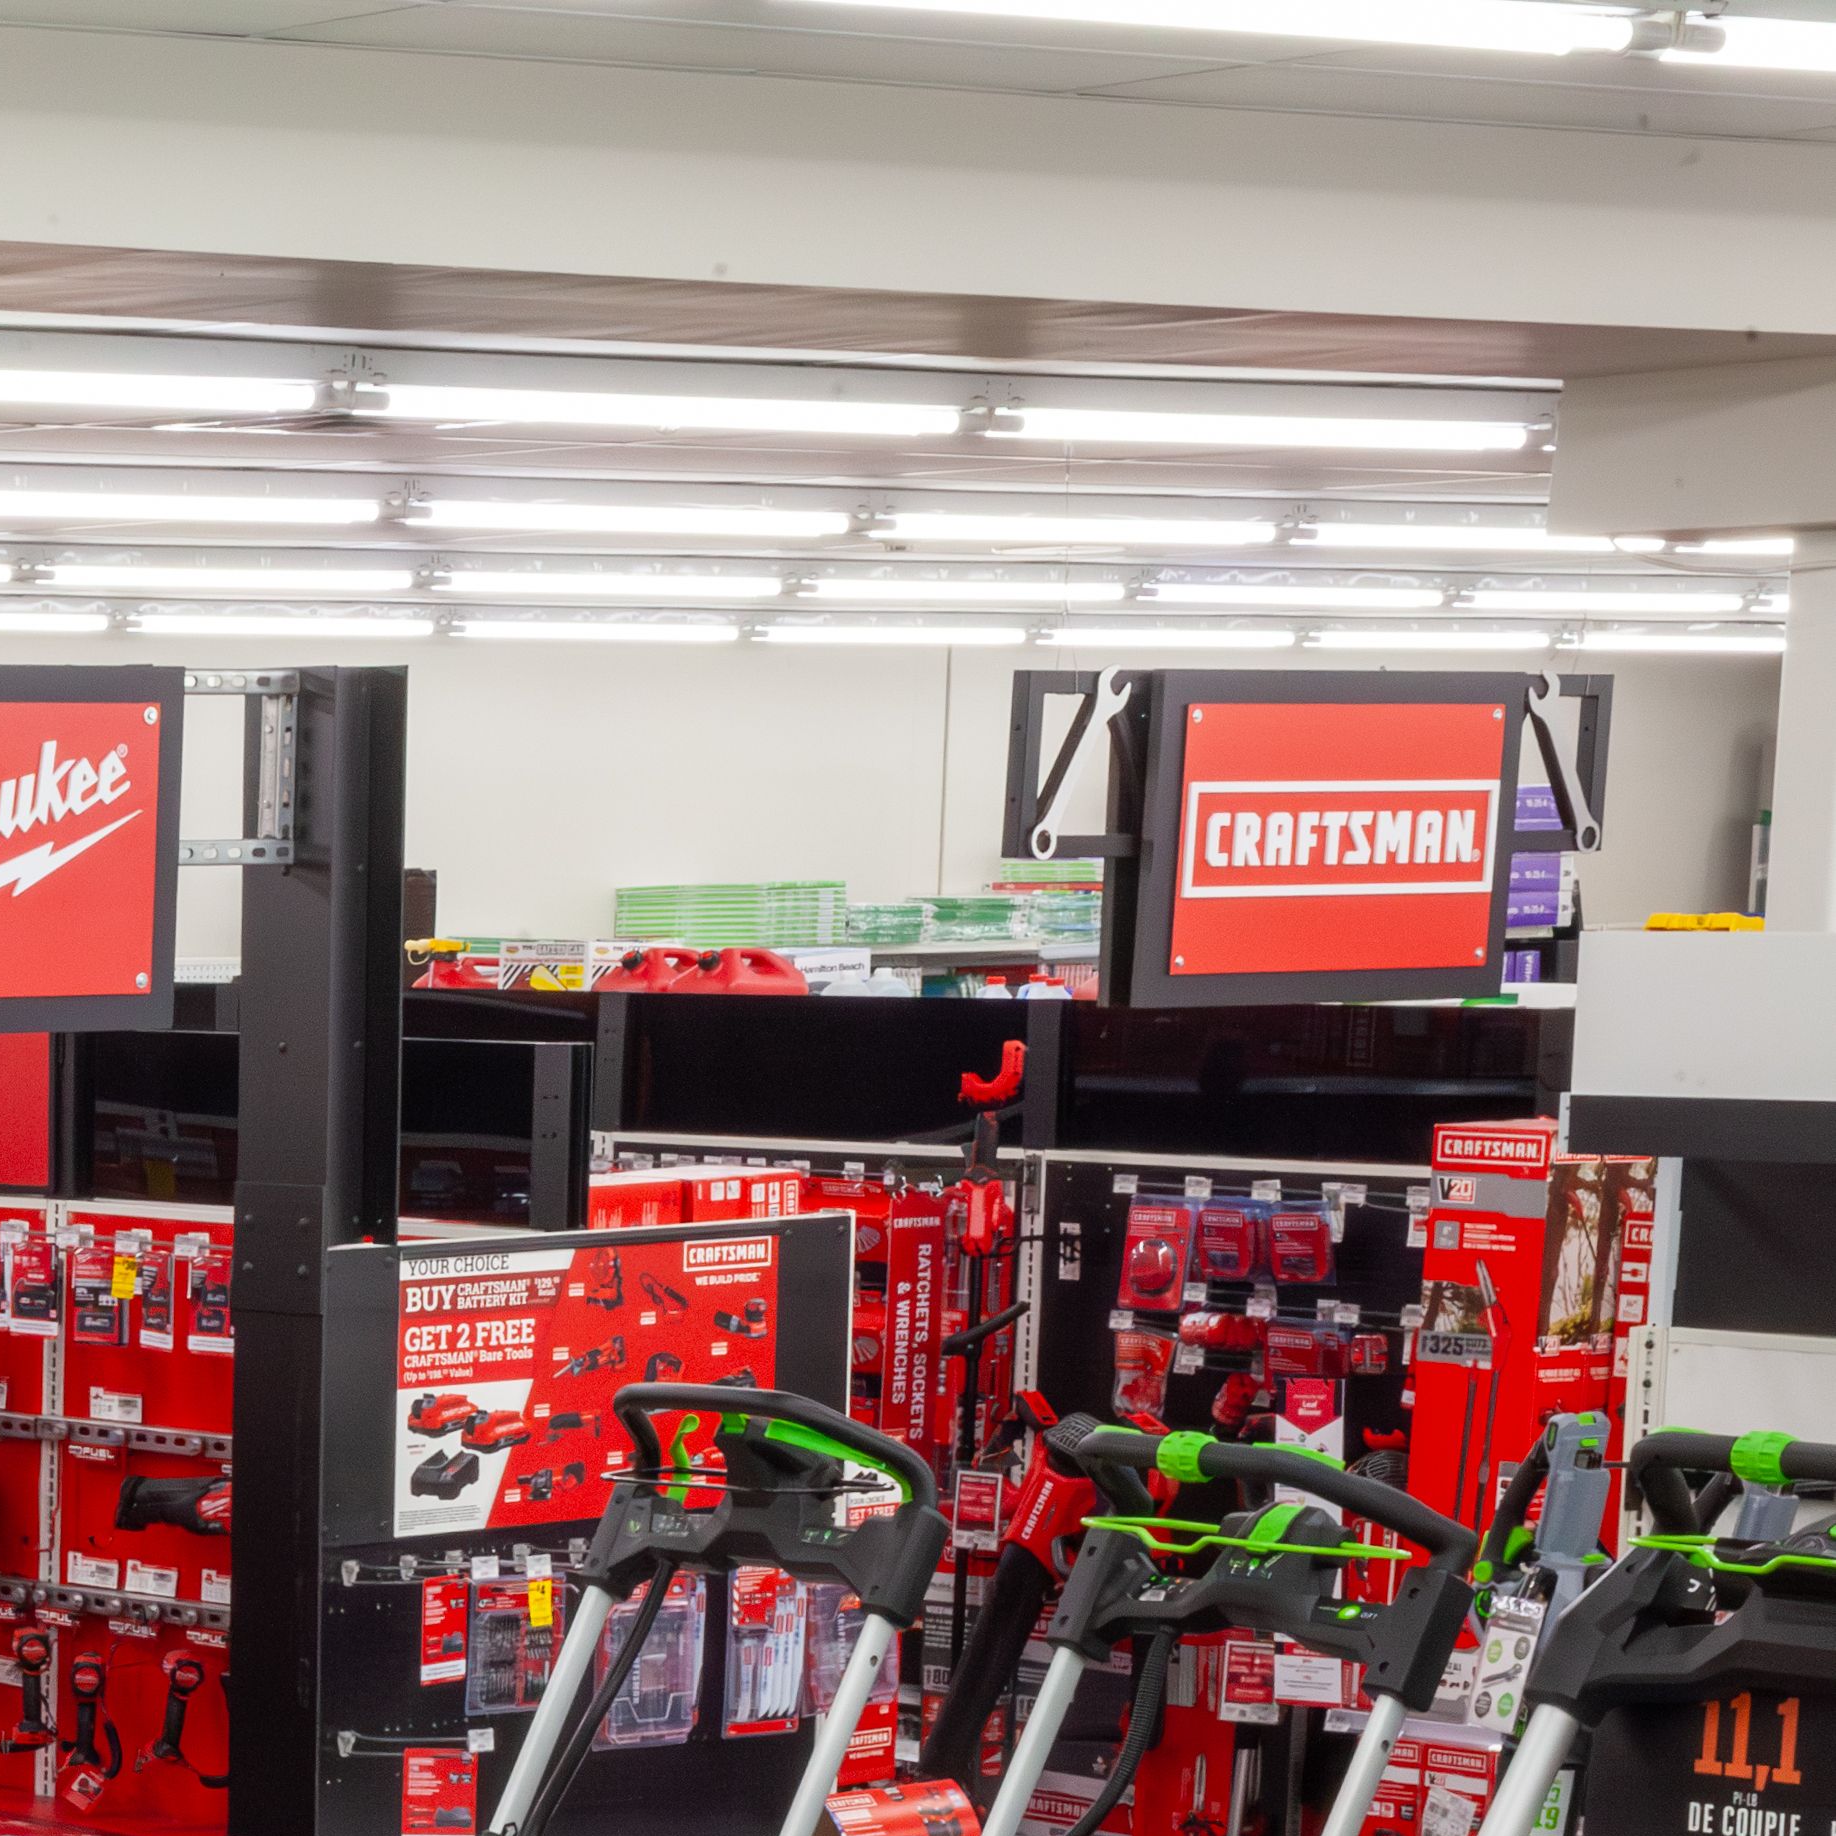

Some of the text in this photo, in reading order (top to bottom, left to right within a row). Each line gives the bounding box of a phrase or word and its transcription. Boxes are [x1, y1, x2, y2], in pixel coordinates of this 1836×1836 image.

[1205, 808, 1476, 867] CRAFTSMAN
[799, 959, 865, 974] Hamilton Beach
[1444, 1138, 1537, 1158] CRAFTSMAN
[409, 1255, 509, 1276] YOUR CHOICE
[689, 1243, 766, 1265] CRAFTSMAN
[406, 1285, 456, 1312] BUY
[457, 1292, 528, 1309] BATTERY KIT
[405, 1319, 535, 1352] GET 2 FREE
[908, 1244, 932, 1440] RATCHETS, SOCKETS
[479, 1347, 533, 1362] Bare Tools
[892, 1299, 908, 1405] WRENCHES
[1020, 1479, 1056, 1542] CRAFTSMAN
[1693, 1691, 1802, 1792] 11,1
[1432, 1753, 1486, 1771] CRAFTSMAN
[1688, 1801, 1728, 1835] DE
